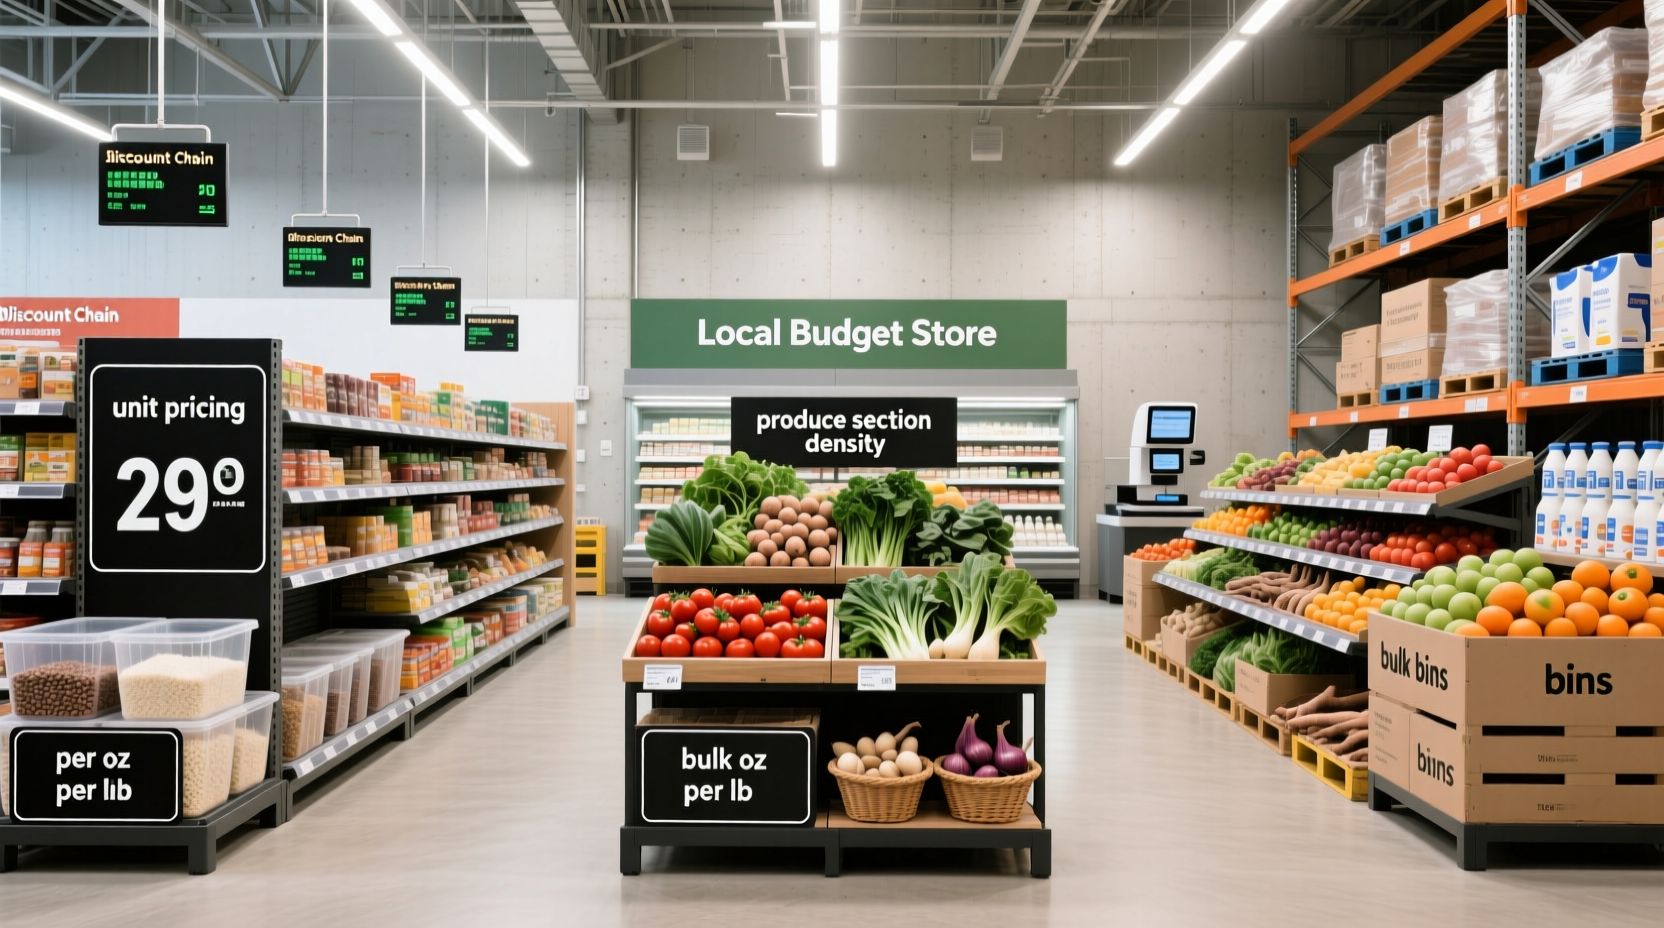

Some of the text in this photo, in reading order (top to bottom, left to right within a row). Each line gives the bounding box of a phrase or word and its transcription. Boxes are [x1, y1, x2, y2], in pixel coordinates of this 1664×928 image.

[174, 150, 214, 165] Chain
[74, 306, 119, 323] Chain
[698, 317, 998, 353] Local Budget Store
[112, 395, 245, 425] unit pricing
[756, 408, 932, 434] produce section
[804, 433, 886, 458] density
[1381, 641, 1449, 691] bulk bins
[1545, 662, 1614, 695] bins
[56, 751, 131, 775] per oz
[681, 746, 767, 771] bulk oz
[56, 783, 97, 807] per
[683, 778, 753, 807] per lb
